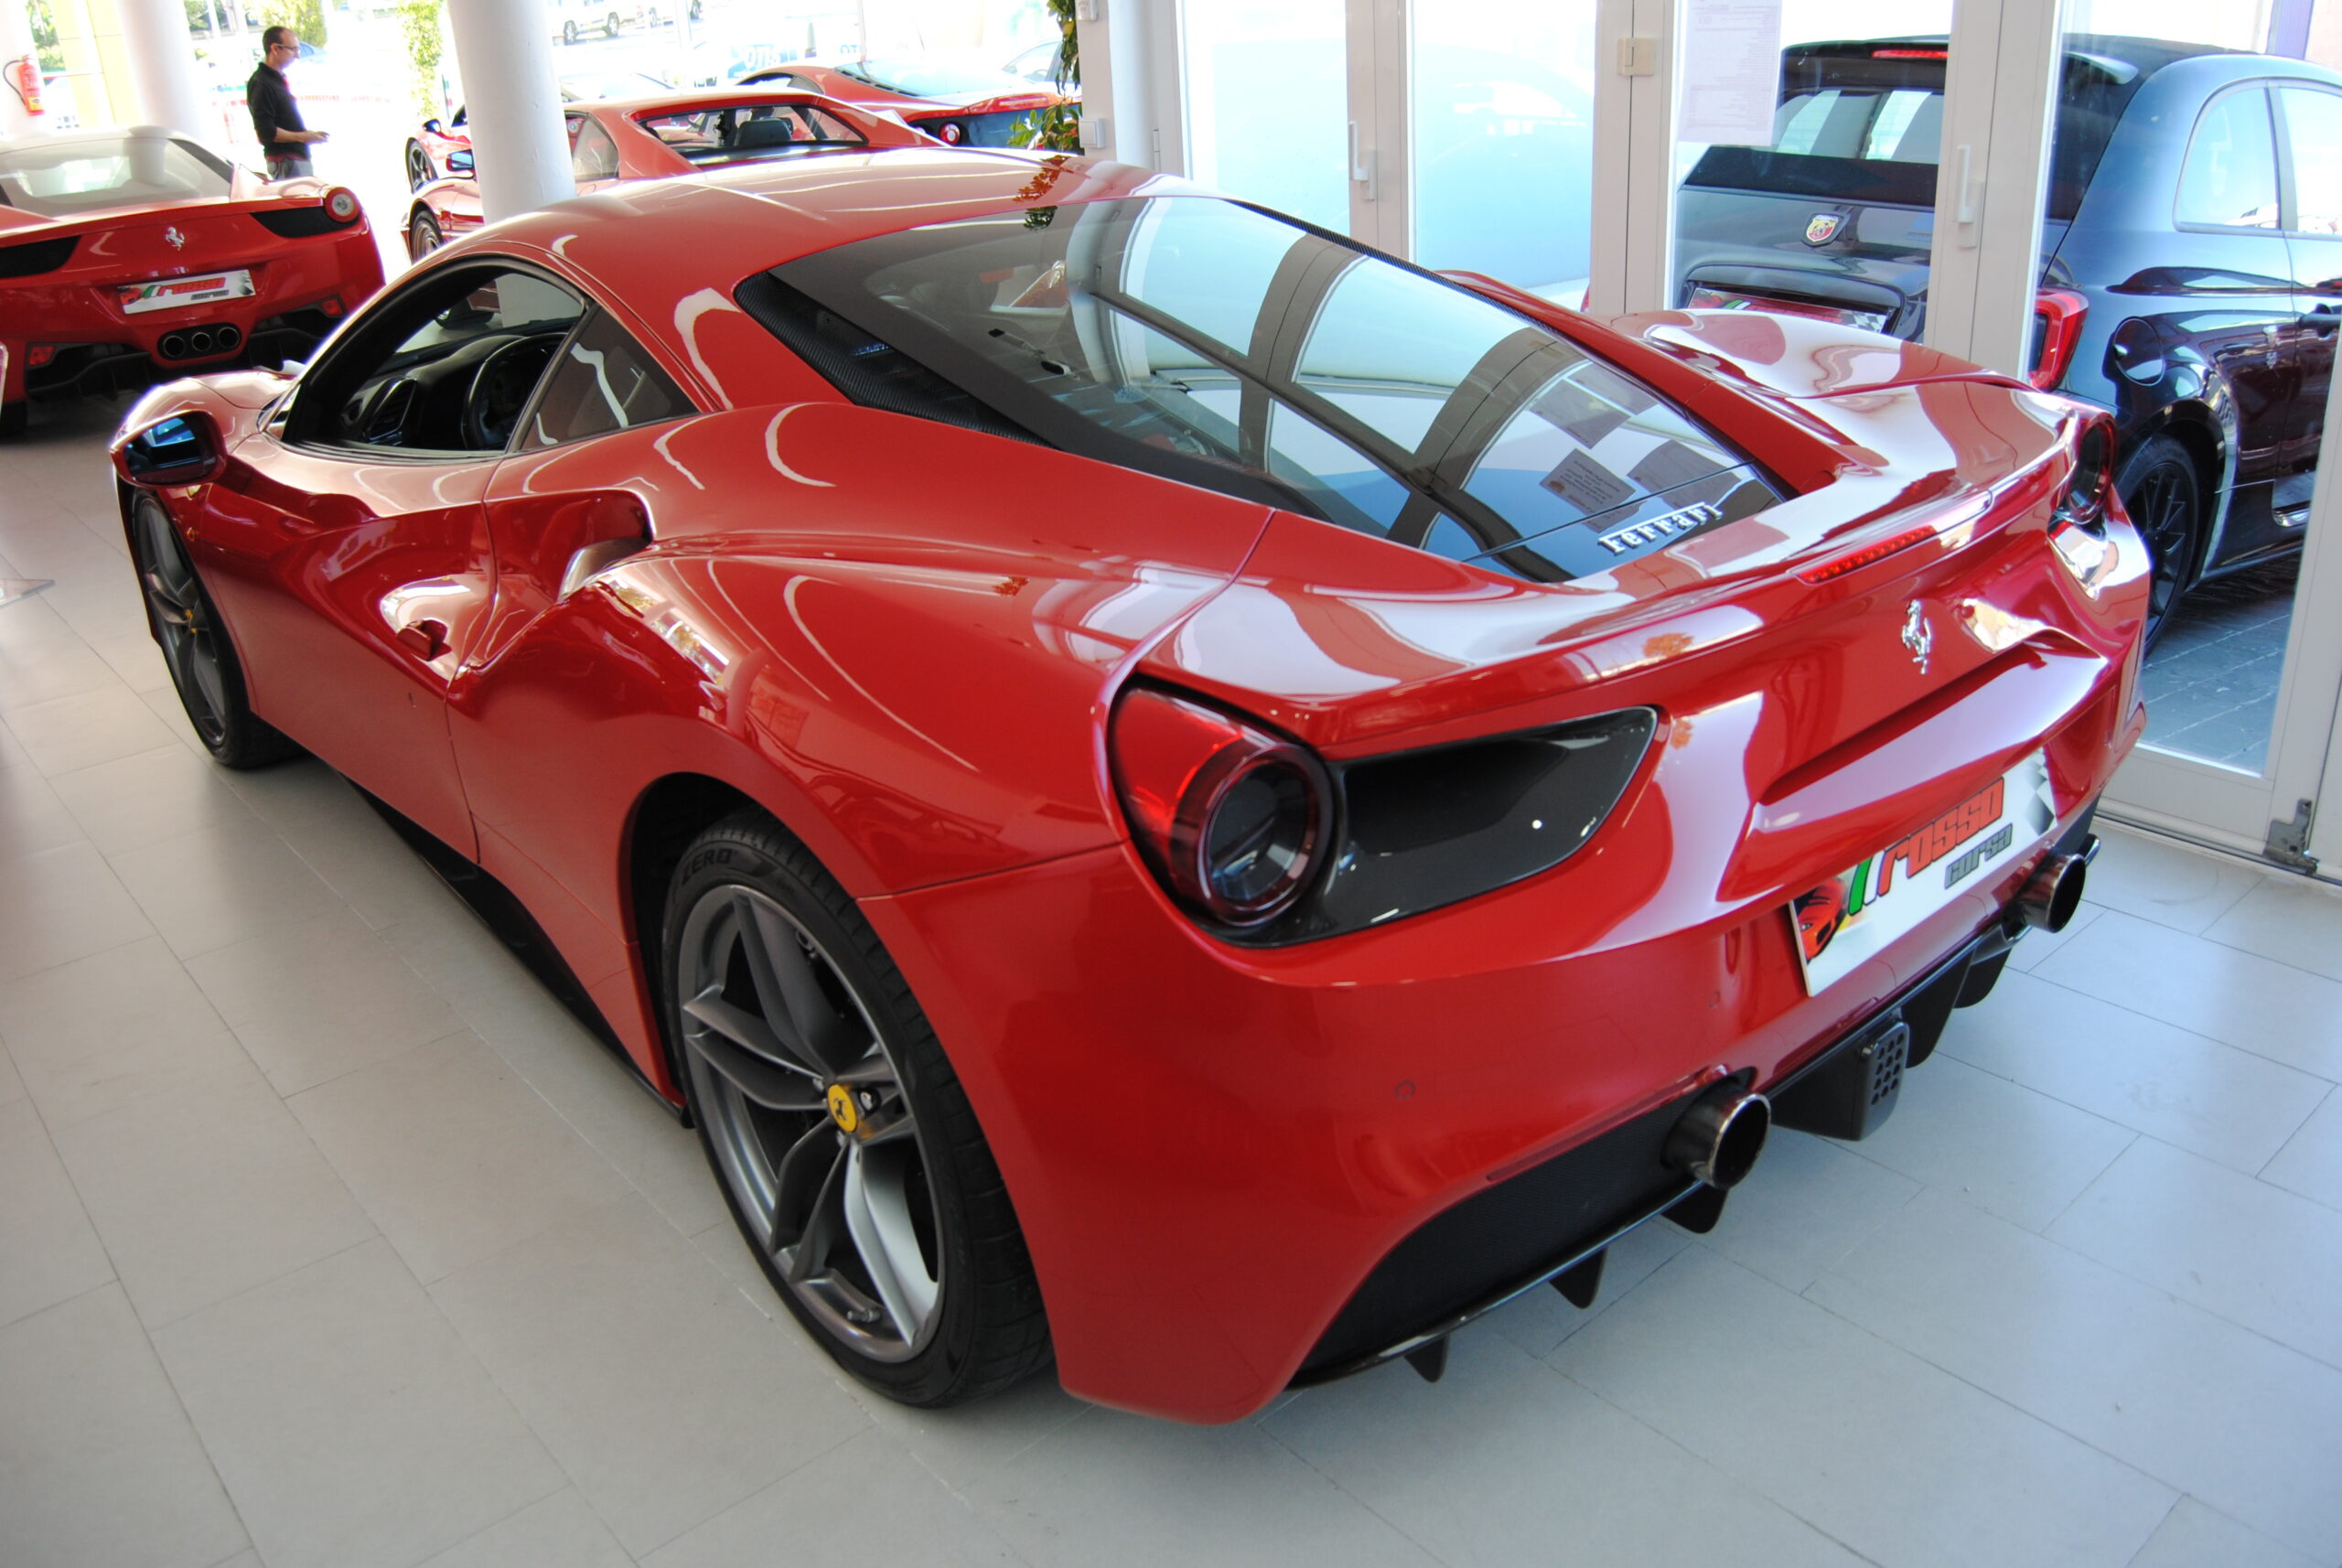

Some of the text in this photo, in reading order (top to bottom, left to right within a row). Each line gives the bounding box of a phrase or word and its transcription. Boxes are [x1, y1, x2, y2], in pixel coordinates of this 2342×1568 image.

[1597, 501, 1724, 556] Ferrari
[682, 847, 733, 886] ZERO
[1877, 776, 2004, 897] rosso
[1944, 822, 2013, 890] corsa
